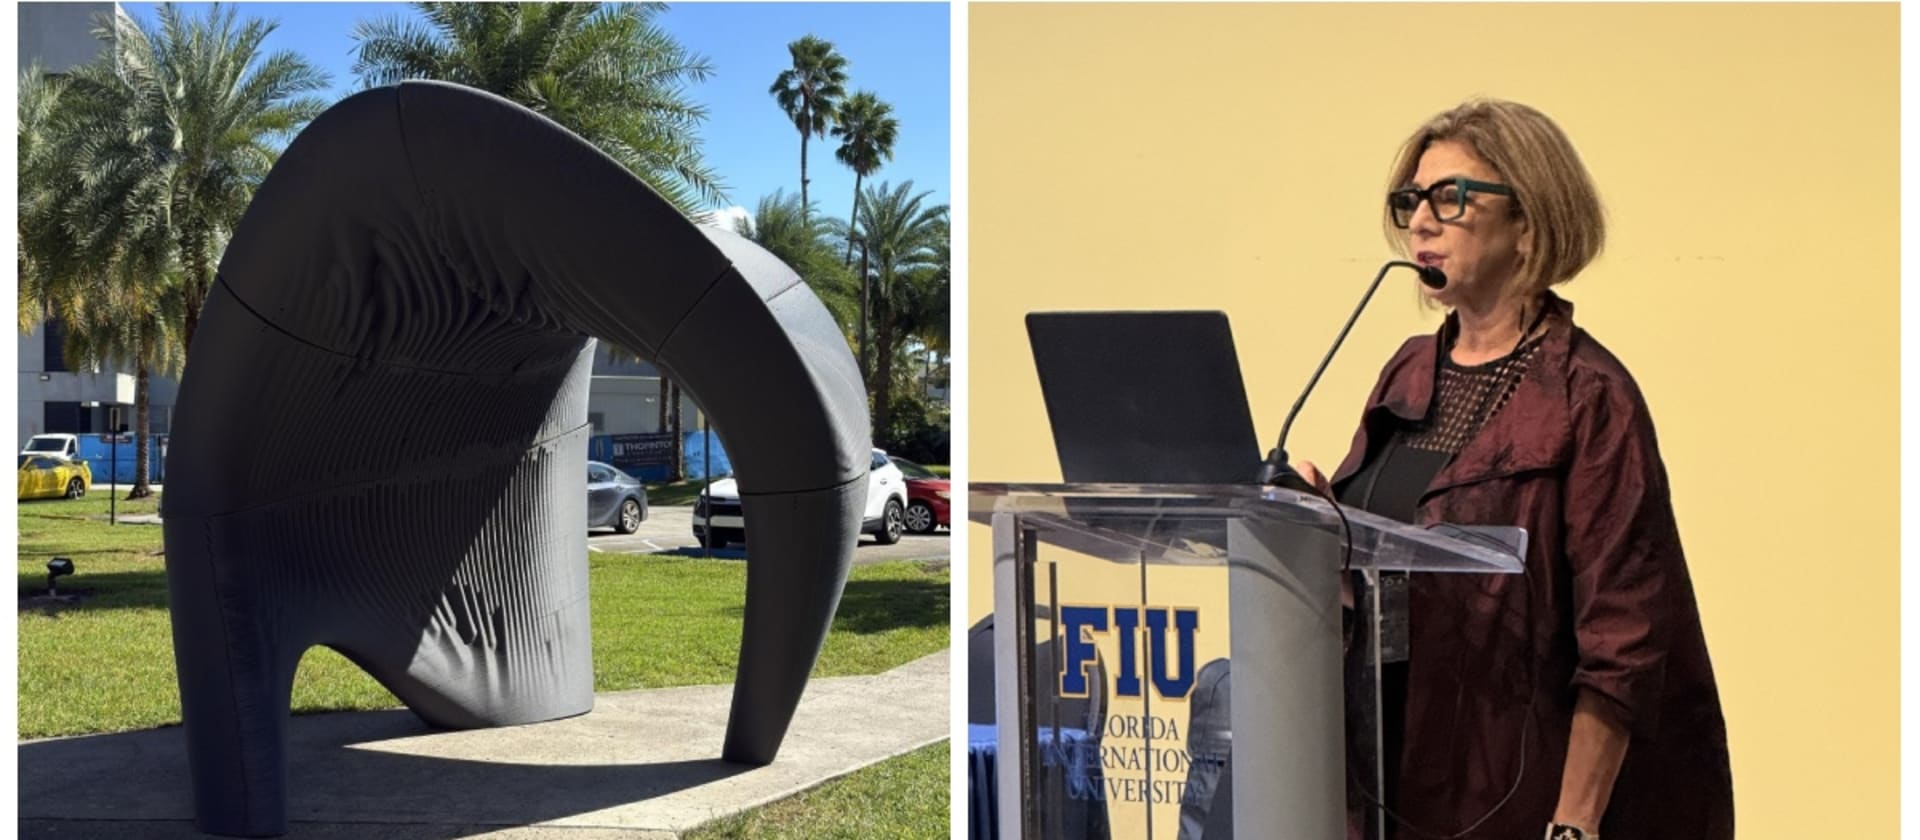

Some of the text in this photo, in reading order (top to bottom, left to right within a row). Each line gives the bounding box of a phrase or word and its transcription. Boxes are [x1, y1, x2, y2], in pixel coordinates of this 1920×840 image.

[625, 441, 672, 450] THORNTO
[1060, 604, 1200, 700] FIU
[1083, 713, 1180, 741] LORIDA
[1044, 742, 1222, 774] NTERNATIONAL
[1068, 776, 1200, 804] UNVERSITY
